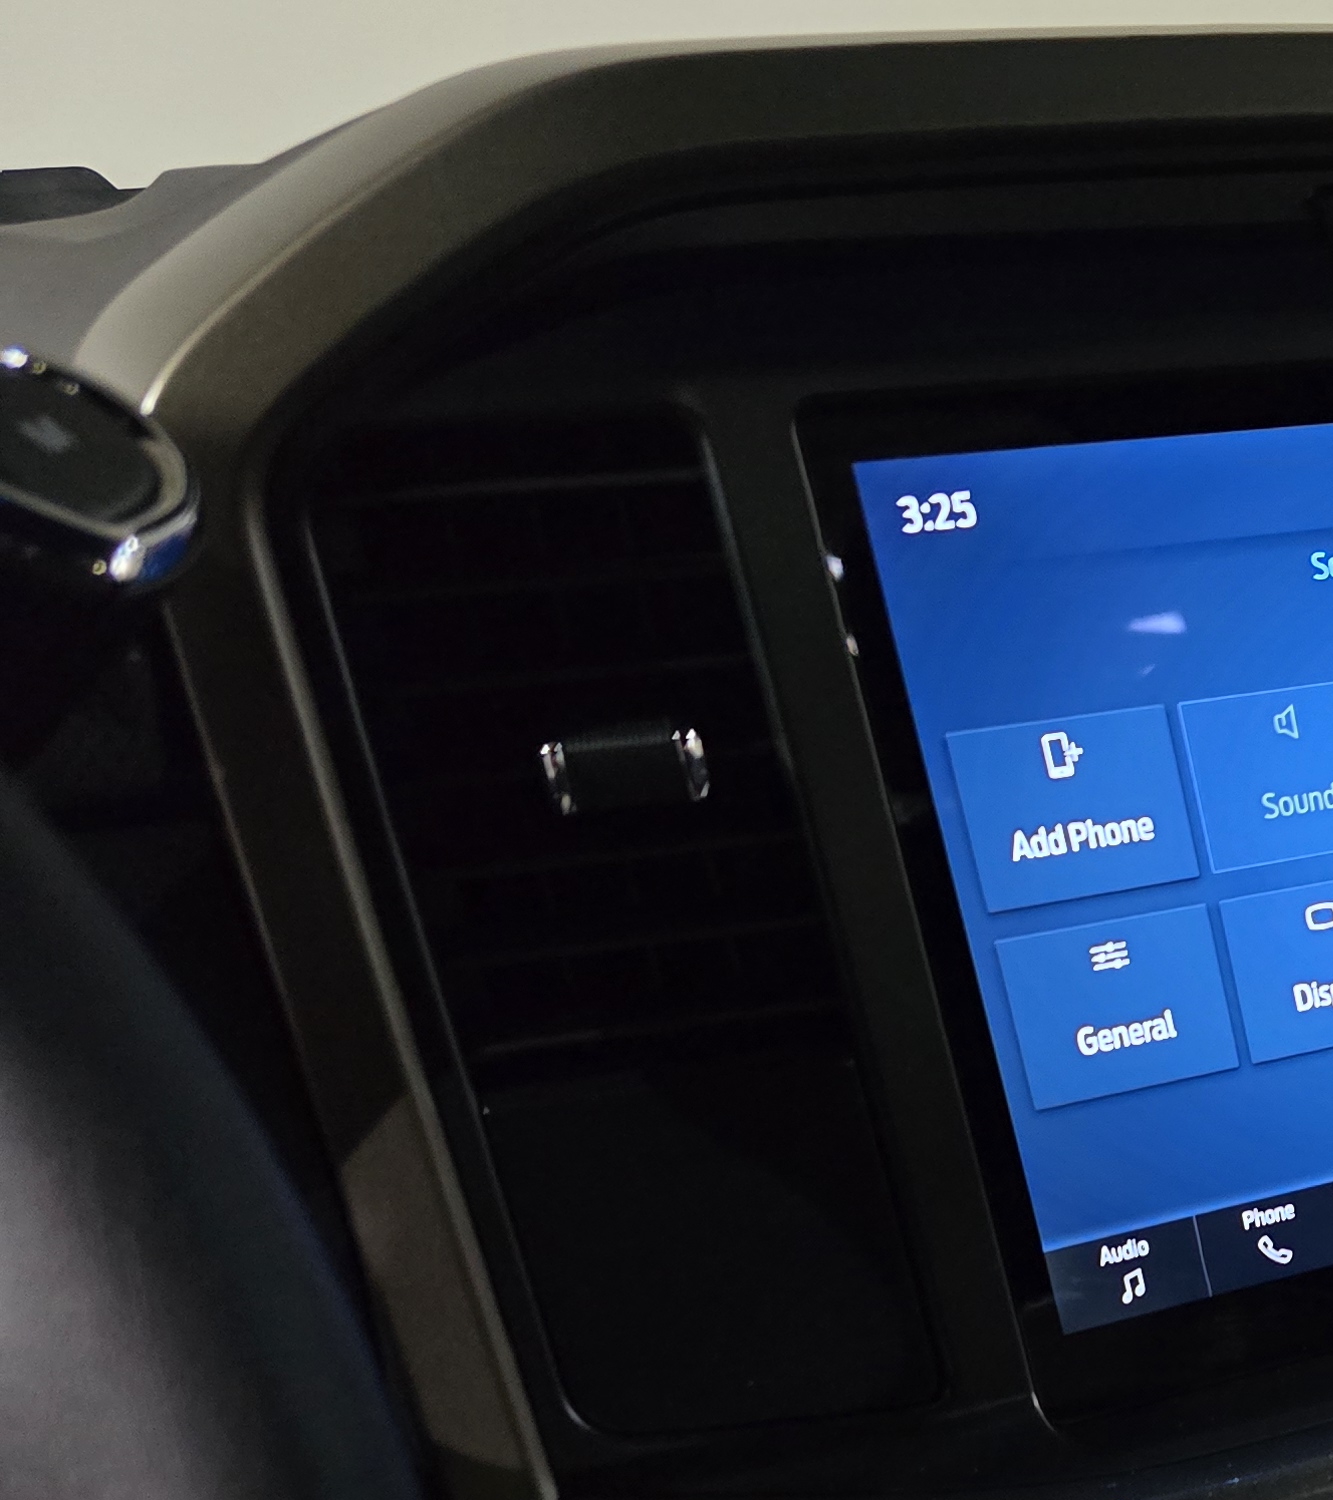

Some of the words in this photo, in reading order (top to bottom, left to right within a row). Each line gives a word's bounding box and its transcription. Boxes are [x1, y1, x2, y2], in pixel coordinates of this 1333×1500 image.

[896, 490, 978, 534] 3:25
[1011, 824, 1067, 863] Add
[1070, 815, 1155, 853] Phone
[1076, 1009, 1178, 1057] General
[1242, 1202, 1296, 1231] Phone
[1099, 1236, 1150, 1267] Audio
